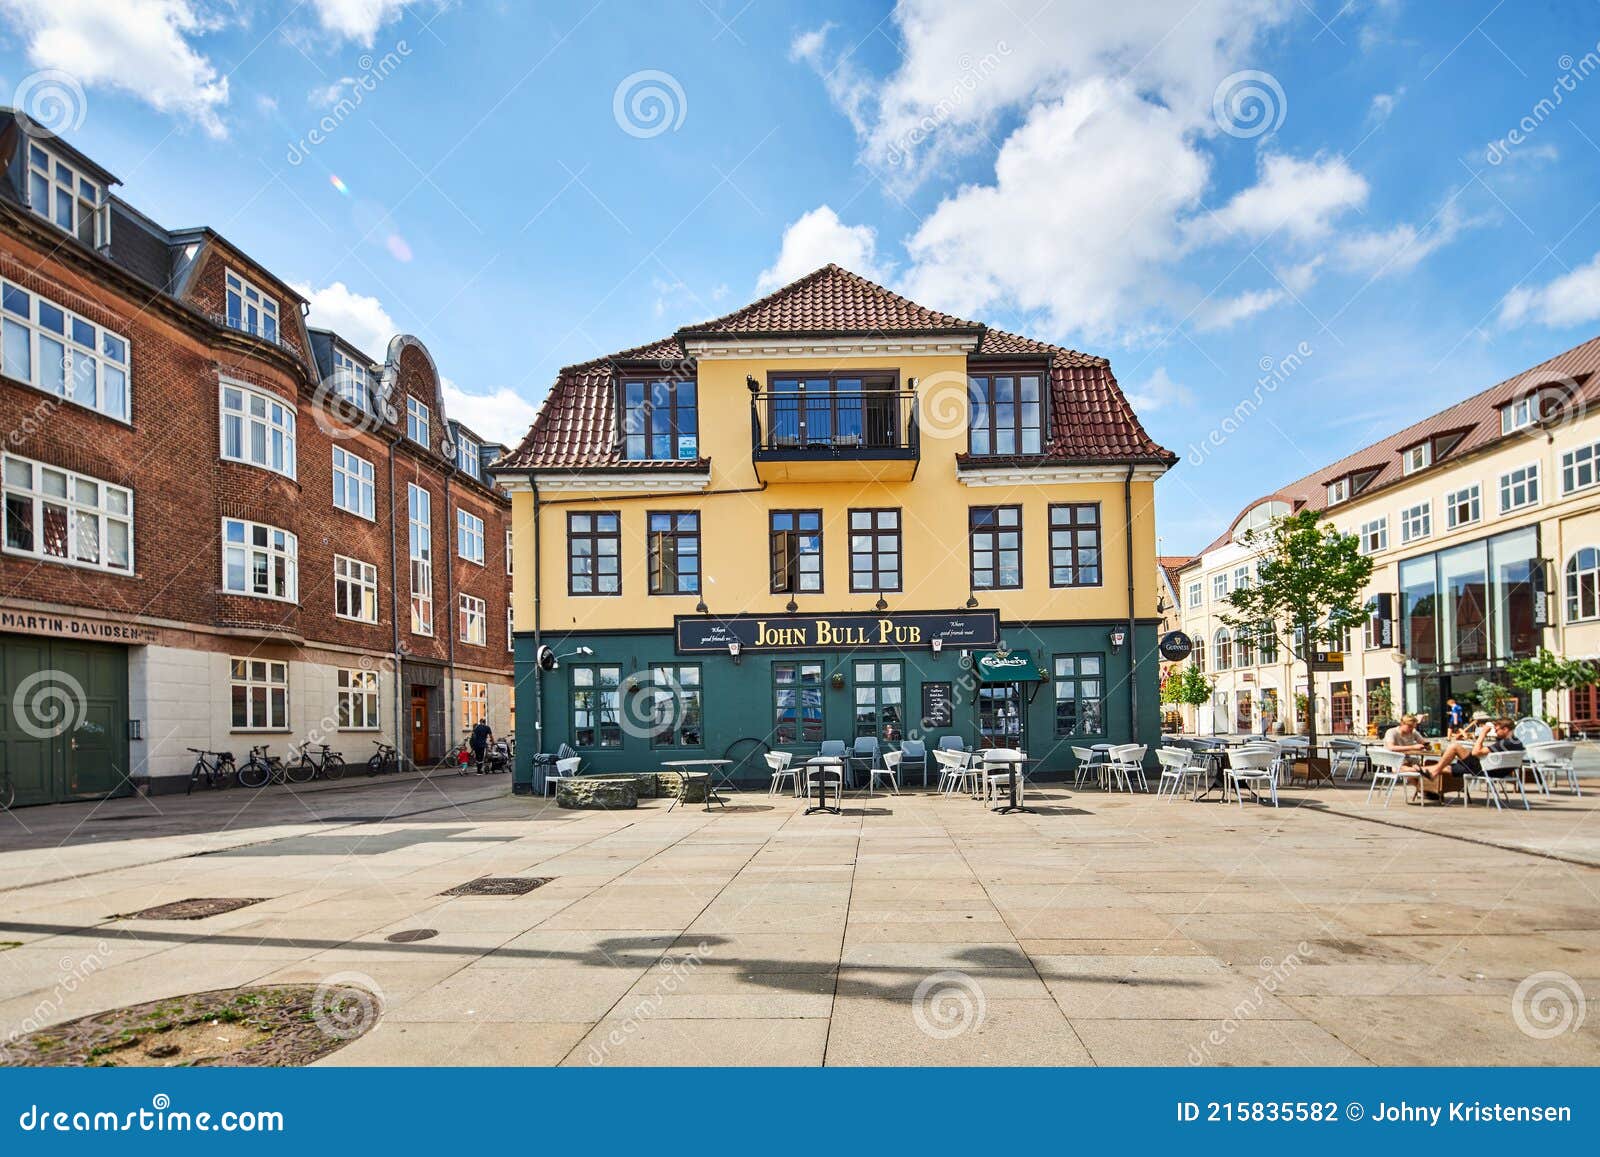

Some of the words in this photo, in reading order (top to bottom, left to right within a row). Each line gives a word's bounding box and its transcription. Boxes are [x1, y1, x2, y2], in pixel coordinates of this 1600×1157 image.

[2, 612, 63, 632] MARTIN
[71, 621, 138, 639] DAVIDSEN
[755, 621, 806, 646] JOHN
[815, 620, 870, 646] BULL
[878, 619, 921, 643] PUB
